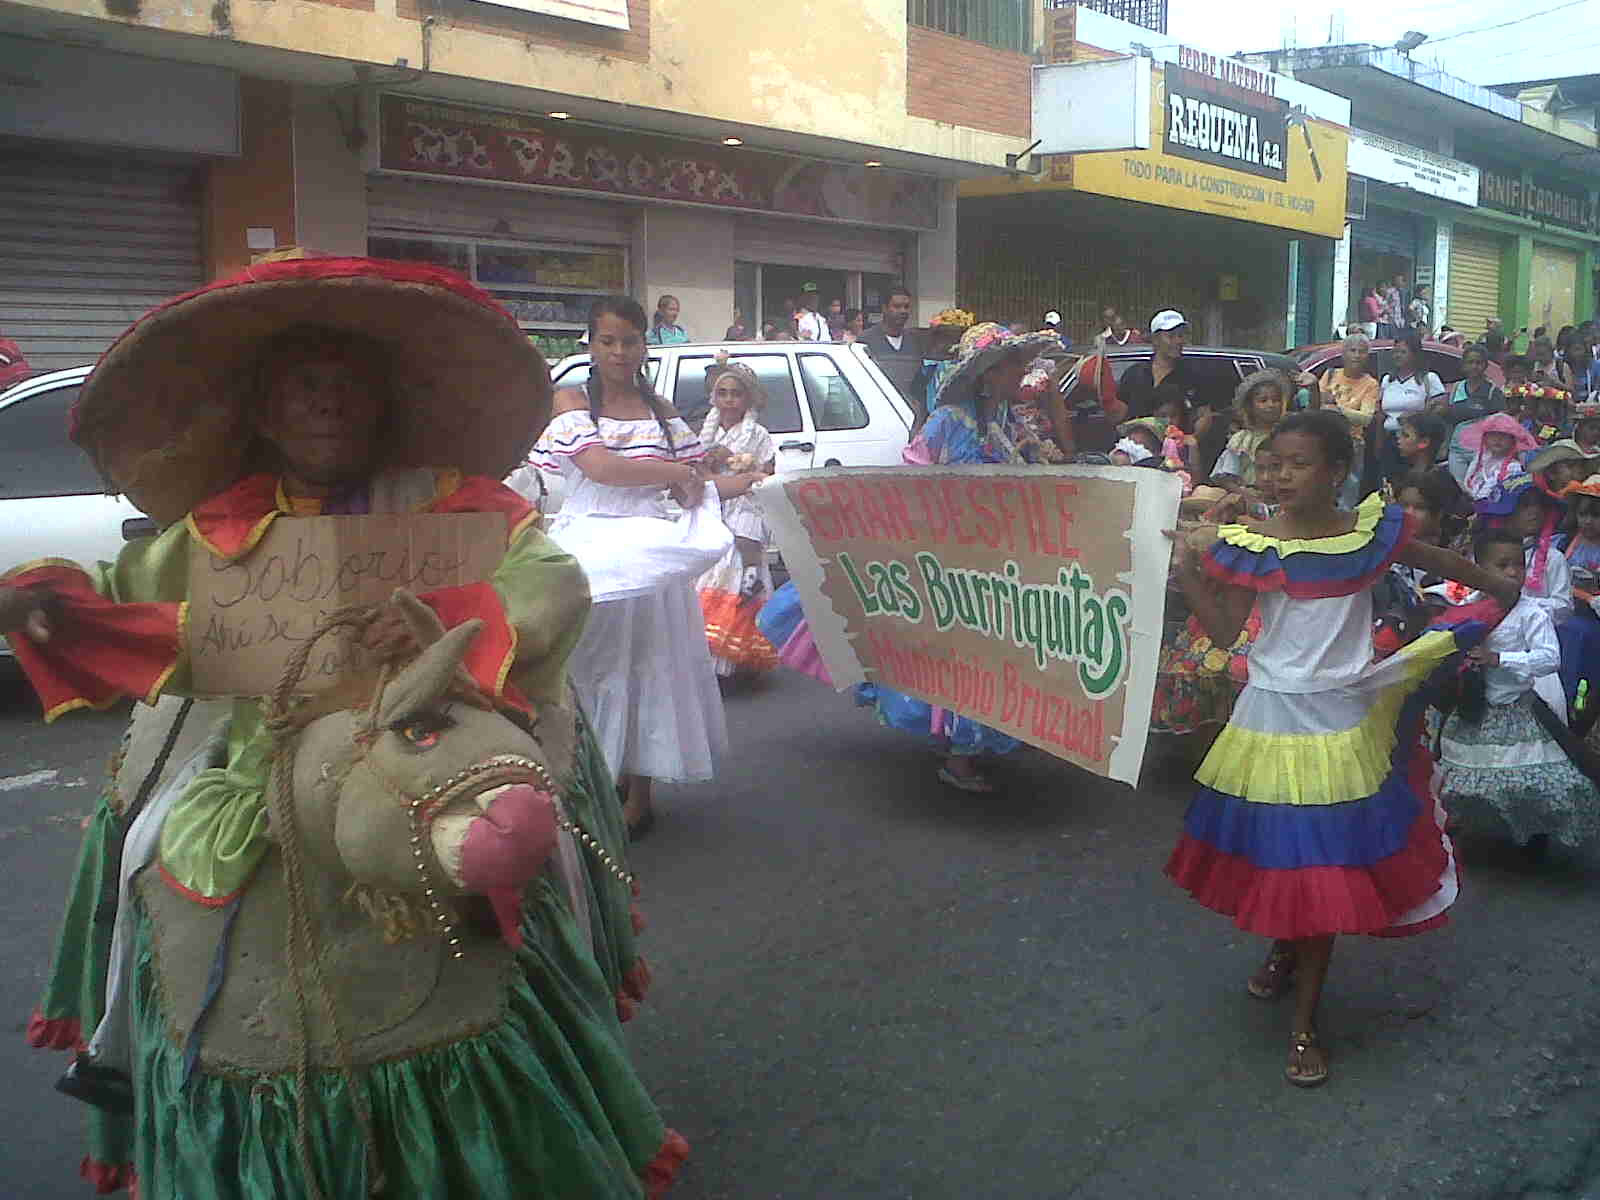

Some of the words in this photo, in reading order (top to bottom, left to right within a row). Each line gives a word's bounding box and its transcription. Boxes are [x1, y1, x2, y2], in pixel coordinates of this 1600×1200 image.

[1168, 92, 1261, 165] REQUENA
[1122, 158, 1153, 180] TODO
[1154, 165, 1183, 185] PARA
[1184, 173, 1200, 188] LA
[800, 479, 918, 543] GRAN
[925, 480, 1081, 560] DESFILE
[837, 552, 921, 622] Las
[916, 552, 1128, 697] Burriquitas
[868, 630, 995, 715] Municipio
[999, 662, 1105, 763] Bruzual
